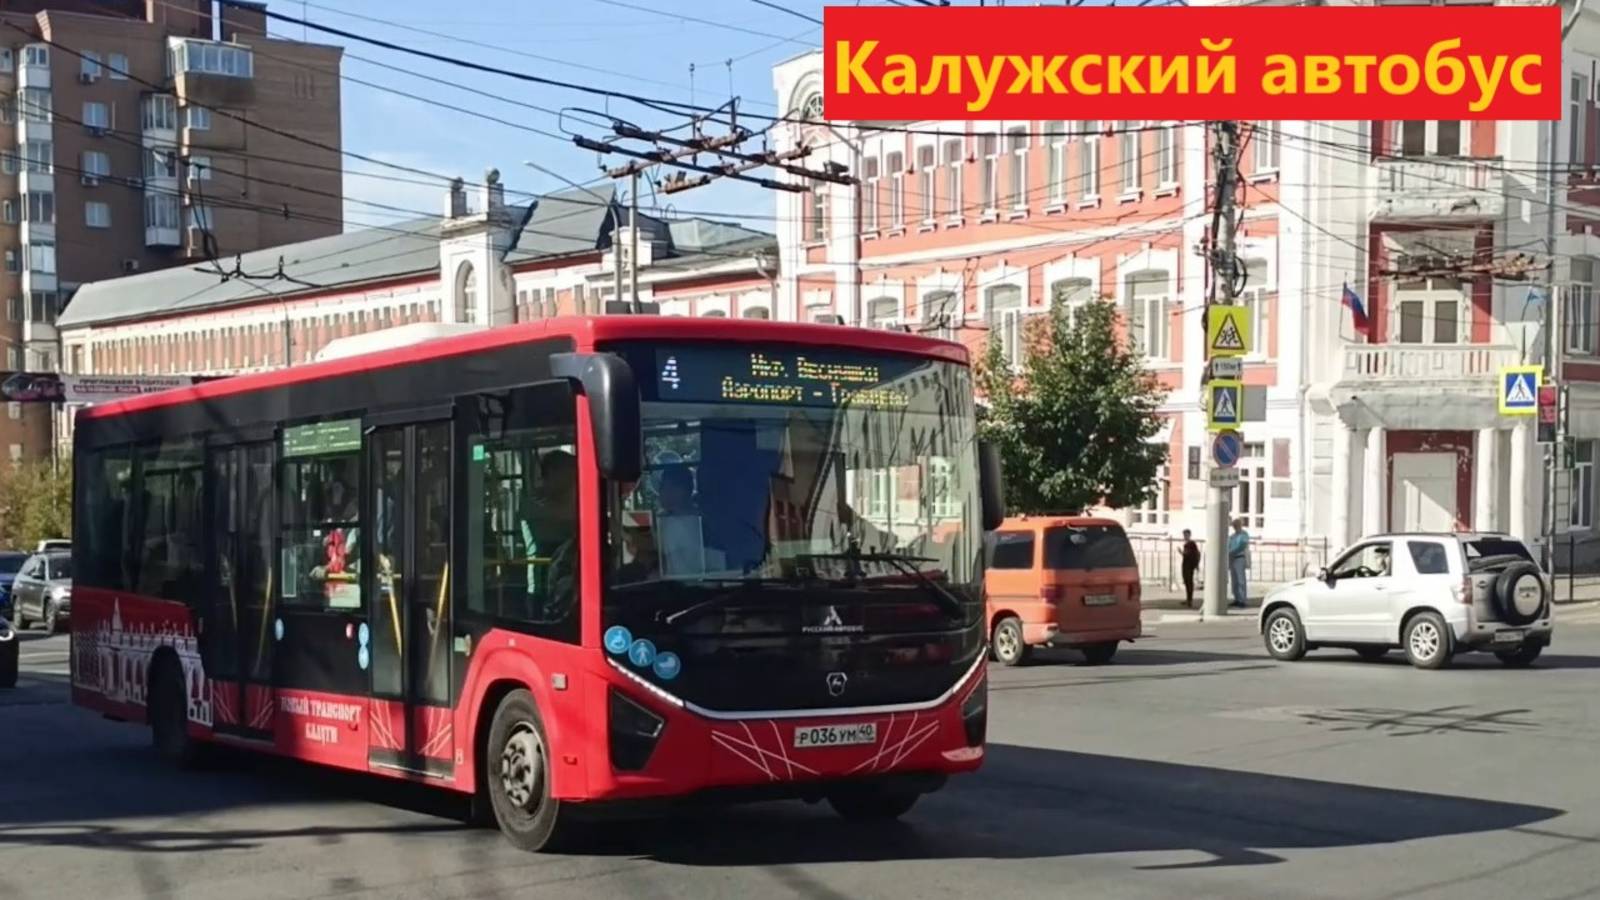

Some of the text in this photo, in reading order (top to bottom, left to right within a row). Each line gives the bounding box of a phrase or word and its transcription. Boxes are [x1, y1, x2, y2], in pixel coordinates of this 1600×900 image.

[661, 356, 681, 390] 4
[310, 699, 362, 722] ТРАНСПОРТ
[305, 722, 338, 746] КАЛУГИ
